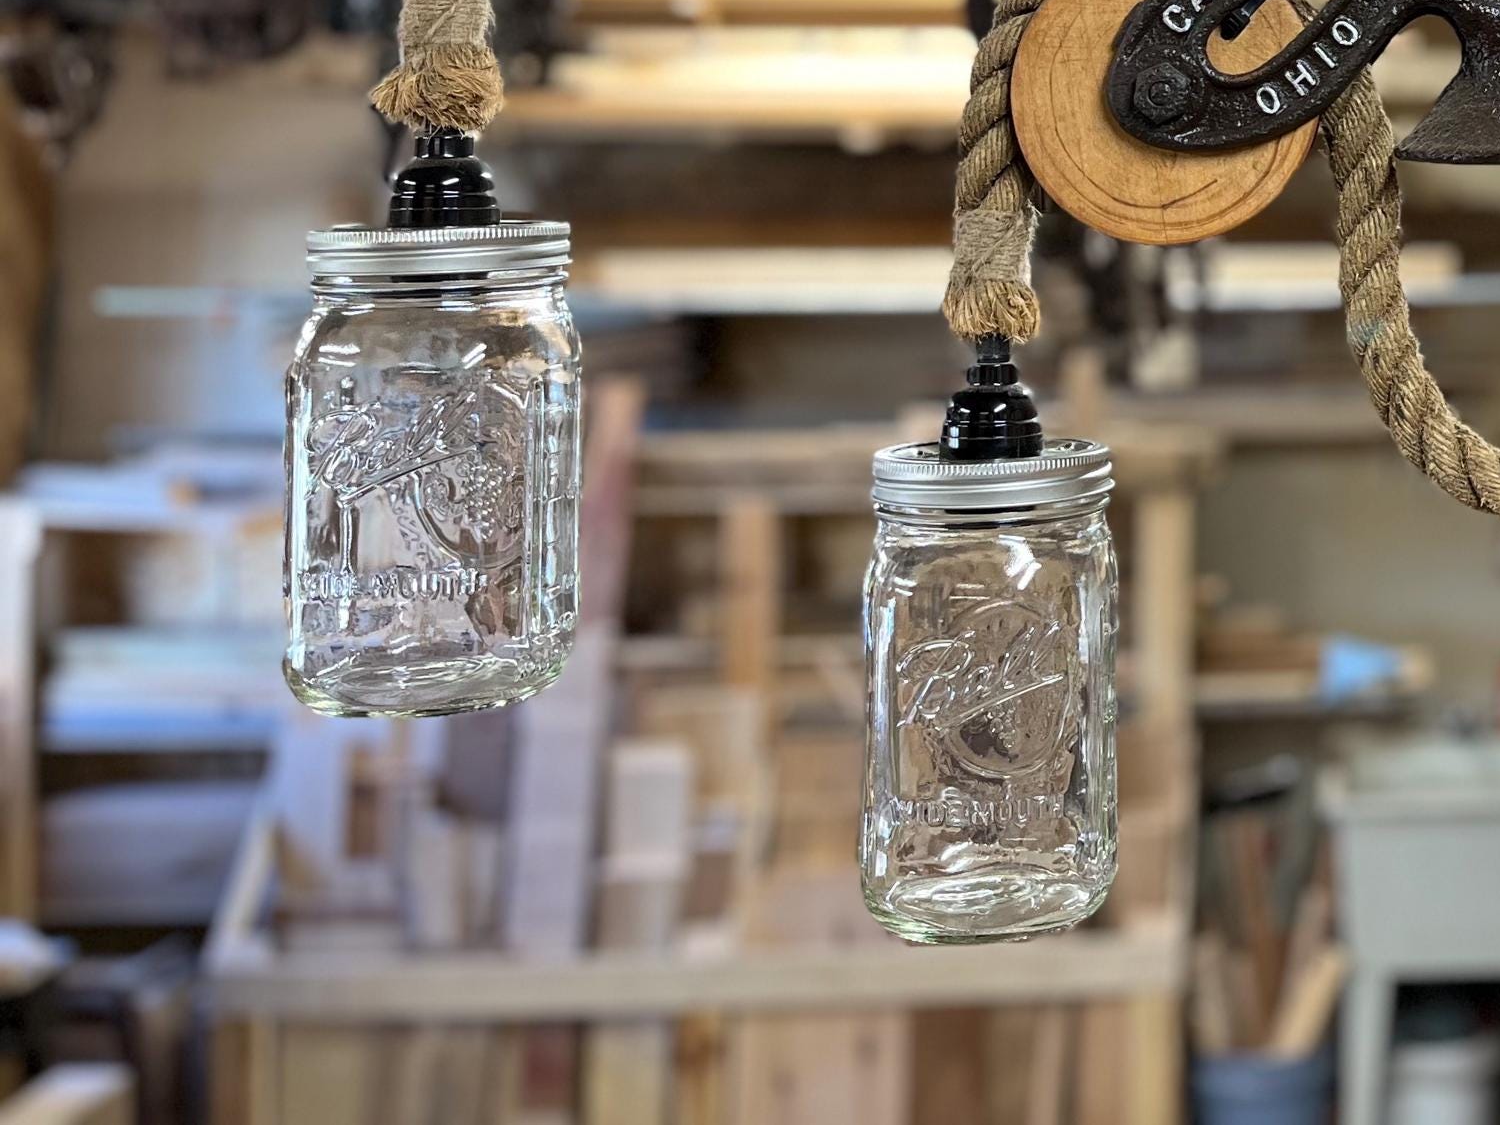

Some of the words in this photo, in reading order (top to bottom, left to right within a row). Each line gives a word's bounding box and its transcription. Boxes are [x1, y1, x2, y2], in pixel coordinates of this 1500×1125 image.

[1256, 19, 1360, 114] OHIO
[304, 391, 477, 508] Ball
[896, 619, 1064, 727] Ball
